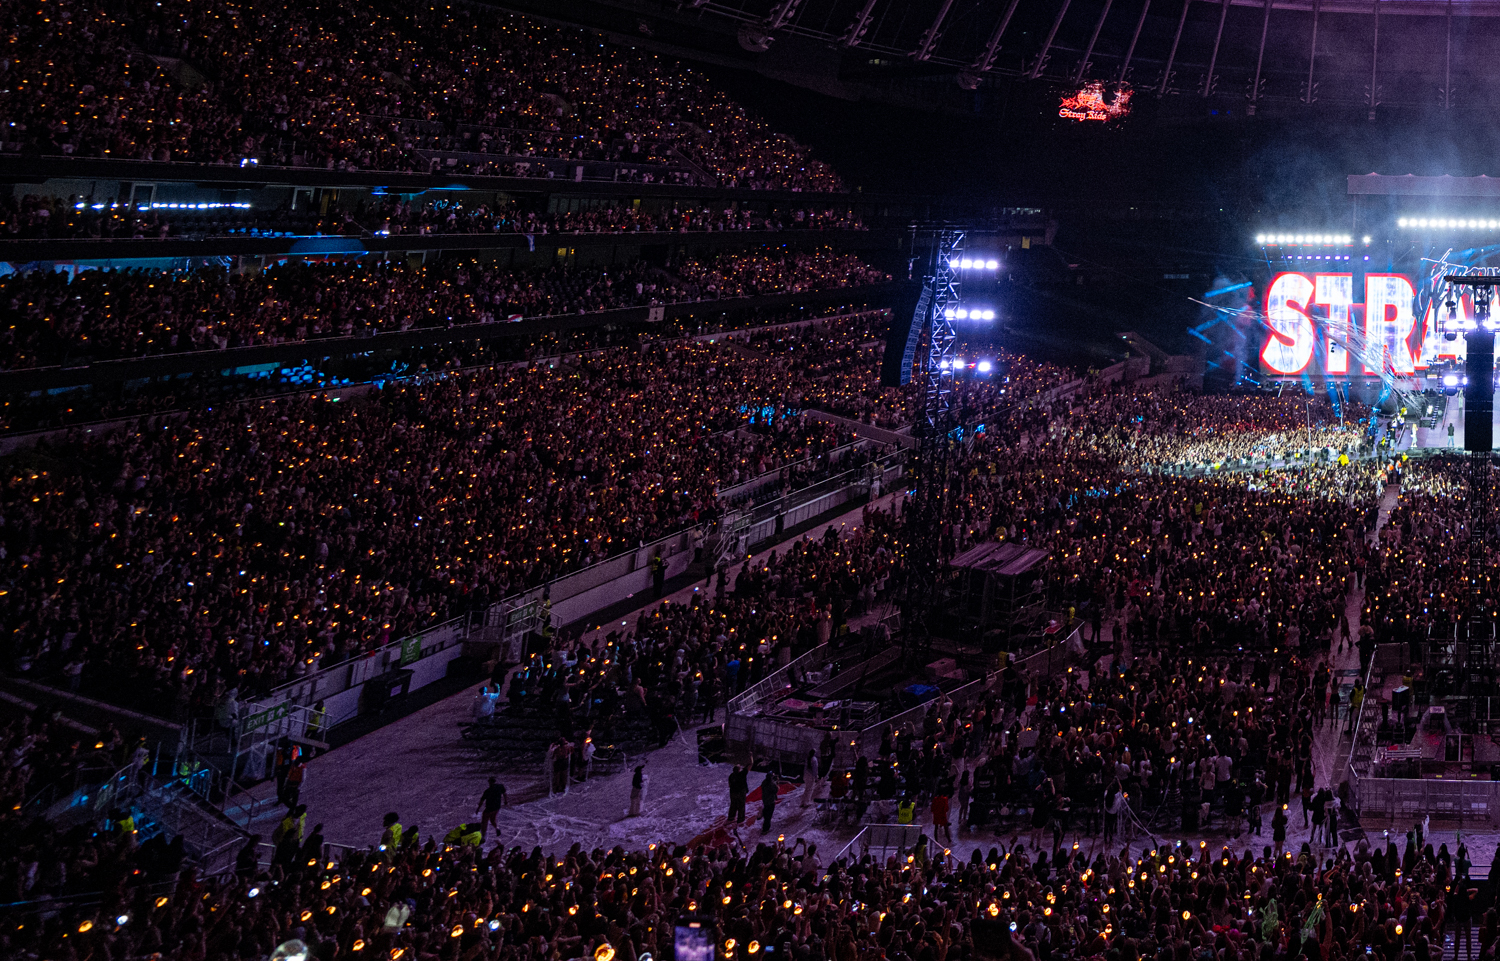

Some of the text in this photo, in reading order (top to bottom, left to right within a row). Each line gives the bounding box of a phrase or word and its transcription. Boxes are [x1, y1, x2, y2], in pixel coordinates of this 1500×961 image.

[1059, 108, 1107, 122] Stray Kids
[247, 714, 266, 729] EXIT
